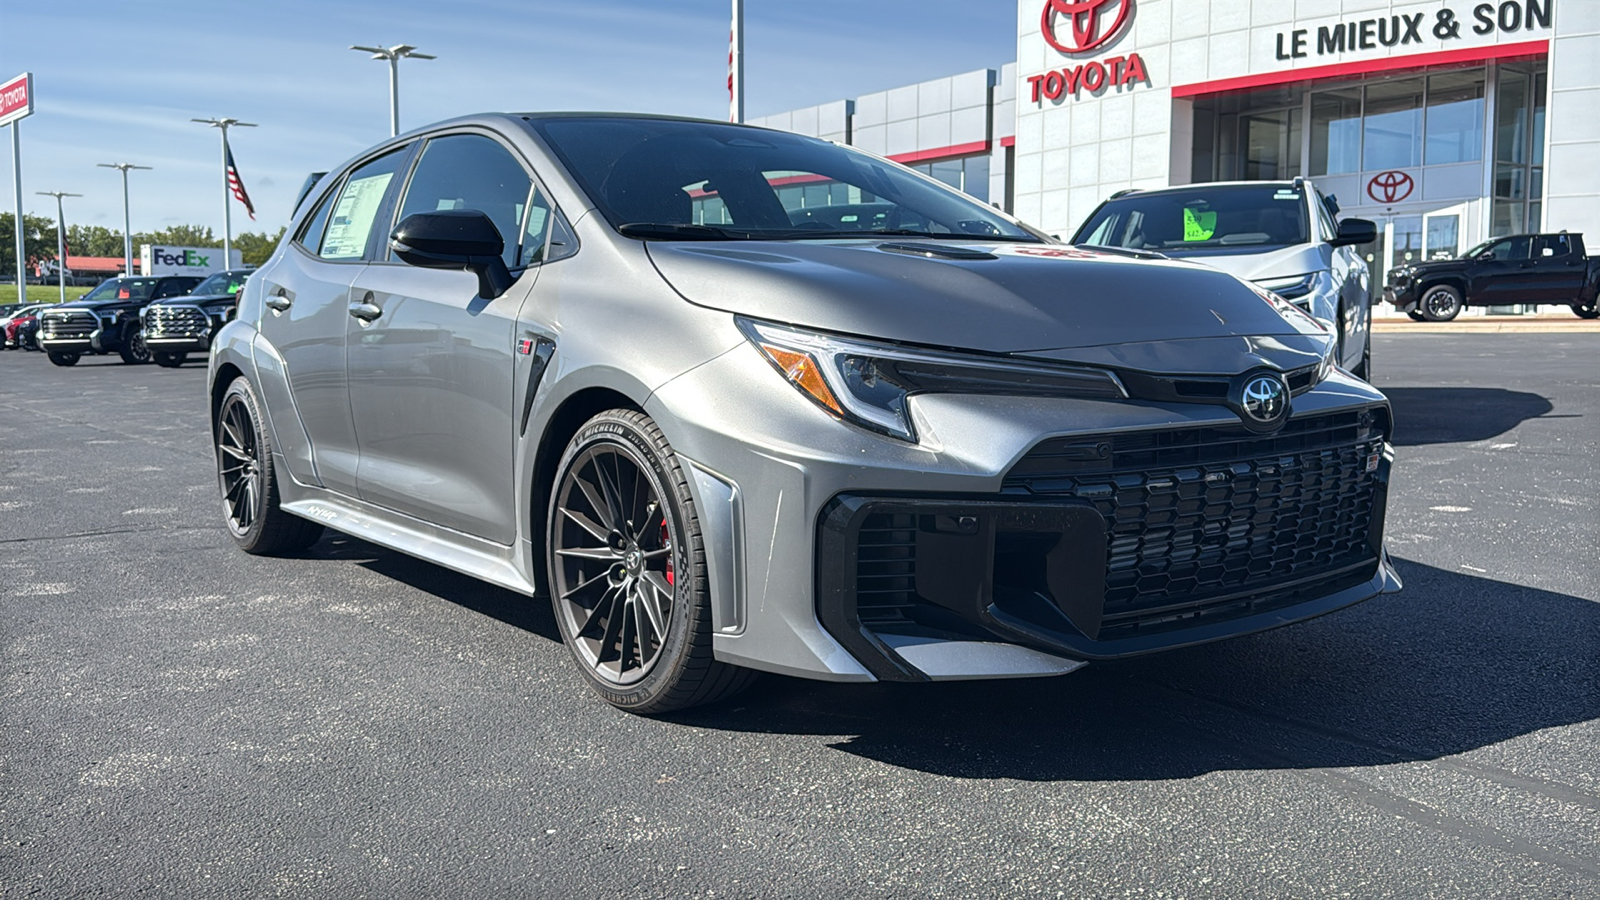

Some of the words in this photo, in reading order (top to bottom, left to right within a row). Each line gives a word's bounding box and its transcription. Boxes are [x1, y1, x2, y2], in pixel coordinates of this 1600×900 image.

[1276, 29, 1308, 61] LE
[1317, 13, 1424, 56] MIEUX
[1433, 8, 1462, 40] &
[1472, 0, 1551, 36] SON
[1027, 52, 1147, 104] TOYOTA
[4, 85, 26, 107] TOYOTA
[154, 249, 209, 267] FedEx
[584, 424, 625, 438] MICHELIN
